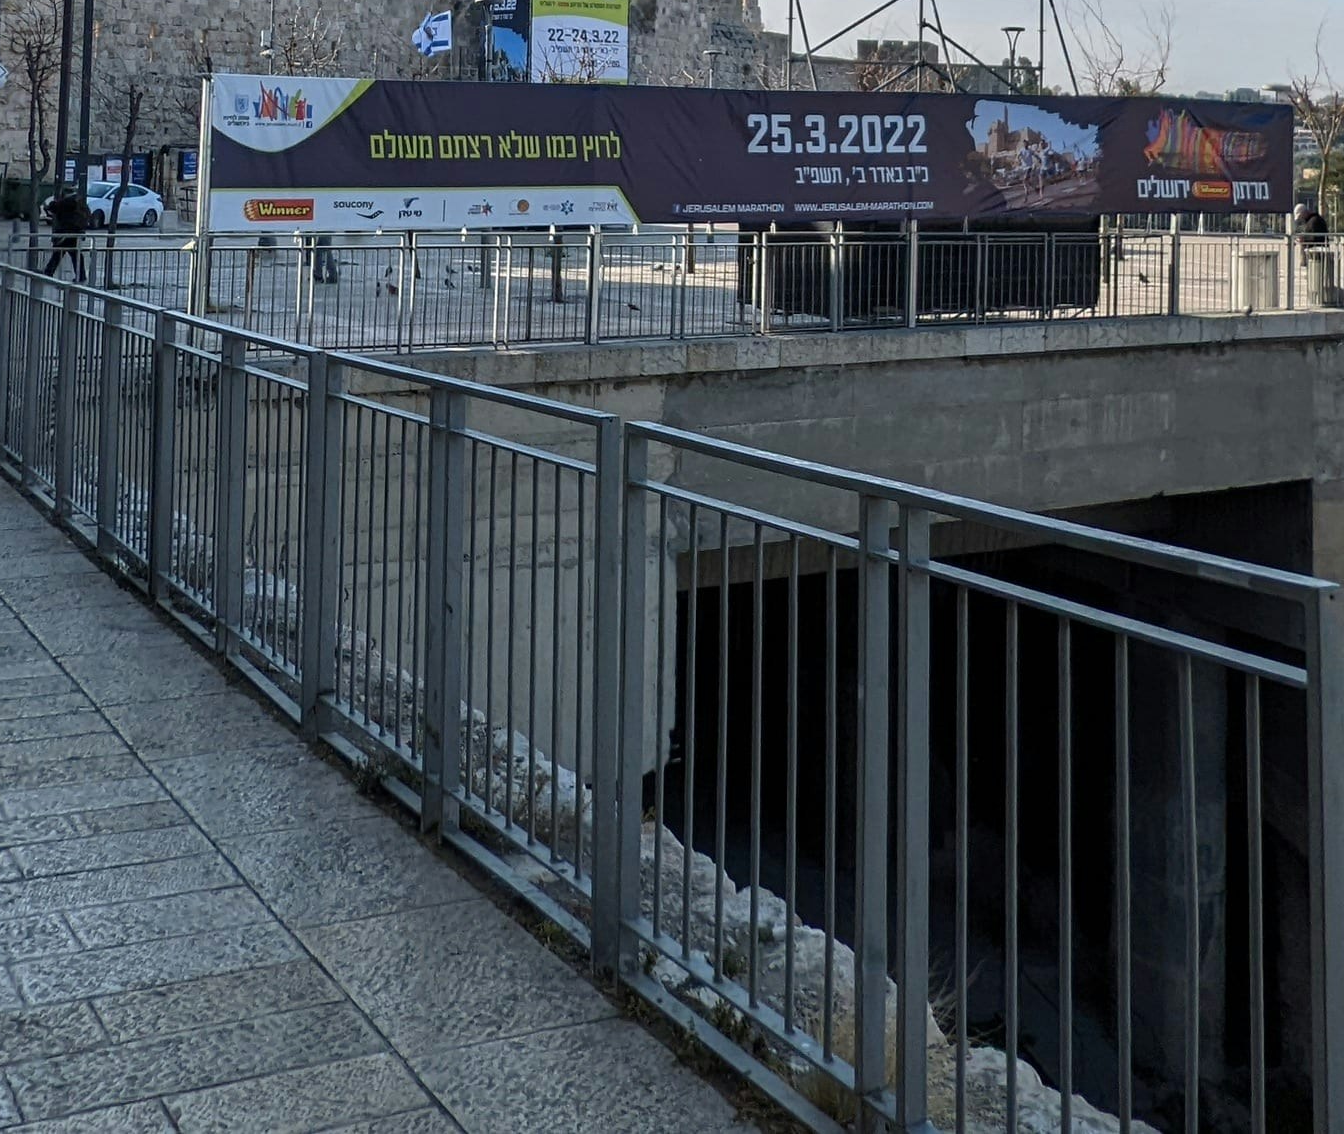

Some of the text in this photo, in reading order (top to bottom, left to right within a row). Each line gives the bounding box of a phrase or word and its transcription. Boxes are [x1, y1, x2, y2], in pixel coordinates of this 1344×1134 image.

[547, 28, 620, 44] 22-24.3.22
[747, 114, 928, 153] 25.3.2022
[369, 129, 622, 162] לרוץ כמו שלא רצתם מעולם
[794, 166, 842, 184] תשפ"ב
[869, 166, 904, 183] באדר
[1136, 175, 1190, 199] ירושלים
[1232, 181, 1270, 205] מרתון
[257, 201, 311, 217] Winner
[333, 200, 375, 209] saucony
[682, 204, 736, 213] JERUSALEM
[736, 203, 785, 213] MARATHON
[794, 201, 934, 212] WWW.JERUSALEM-MARATHON.COM
